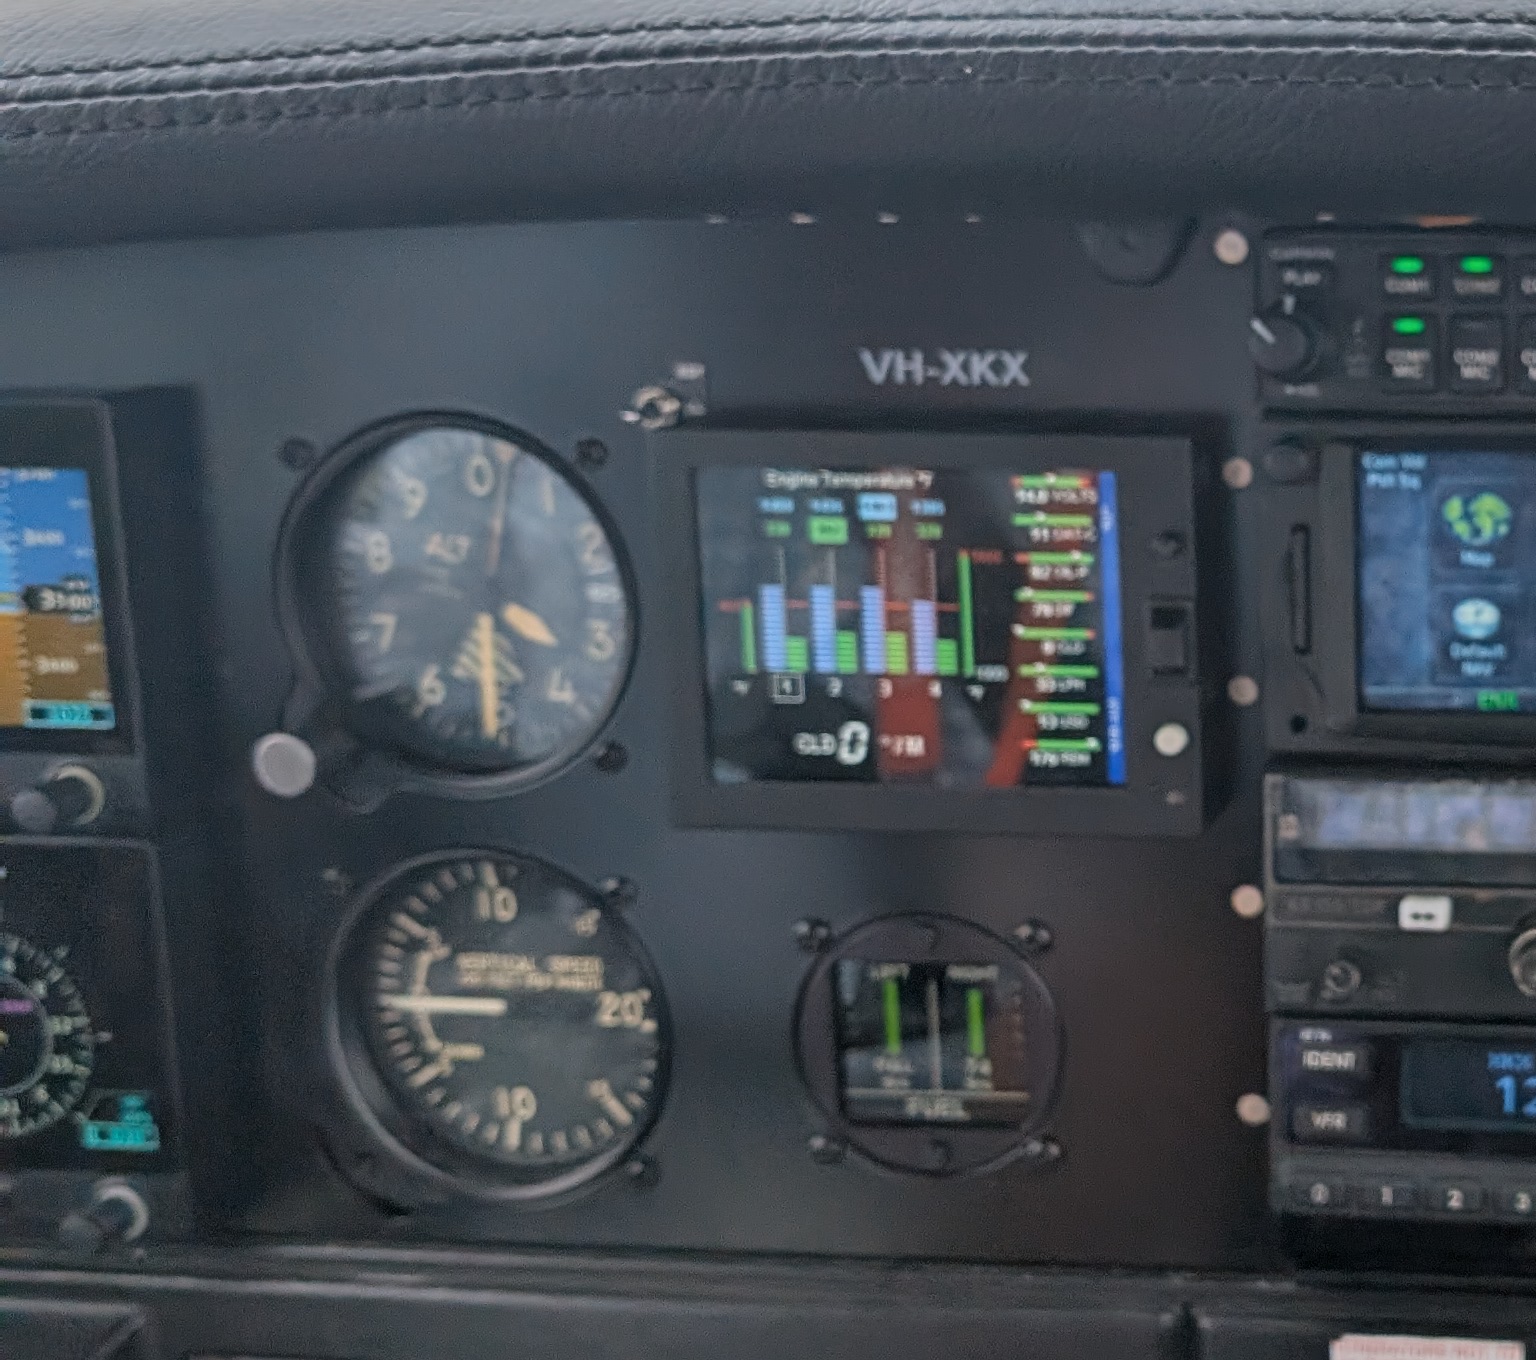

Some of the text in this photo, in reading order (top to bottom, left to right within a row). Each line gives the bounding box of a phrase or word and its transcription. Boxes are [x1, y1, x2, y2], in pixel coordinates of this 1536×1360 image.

[859, 348, 1031, 388] VH-XKX
[465, 453, 495, 497] 0
[400, 477, 427, 520] 9
[365, 530, 394, 573] 8
[586, 621, 615, 663] 3
[546, 668, 575, 705] 4
[836, 720, 870, 765] 0
[475, 887, 518, 922] 10
[597, 990, 644, 1027] 20
[1303, 1050, 1356, 1071] IDENT
[1311, 1110, 1348, 1131] VFR
[1446, 1188, 1465, 1211] 2
[1514, 1191, 1532, 1214] 3
